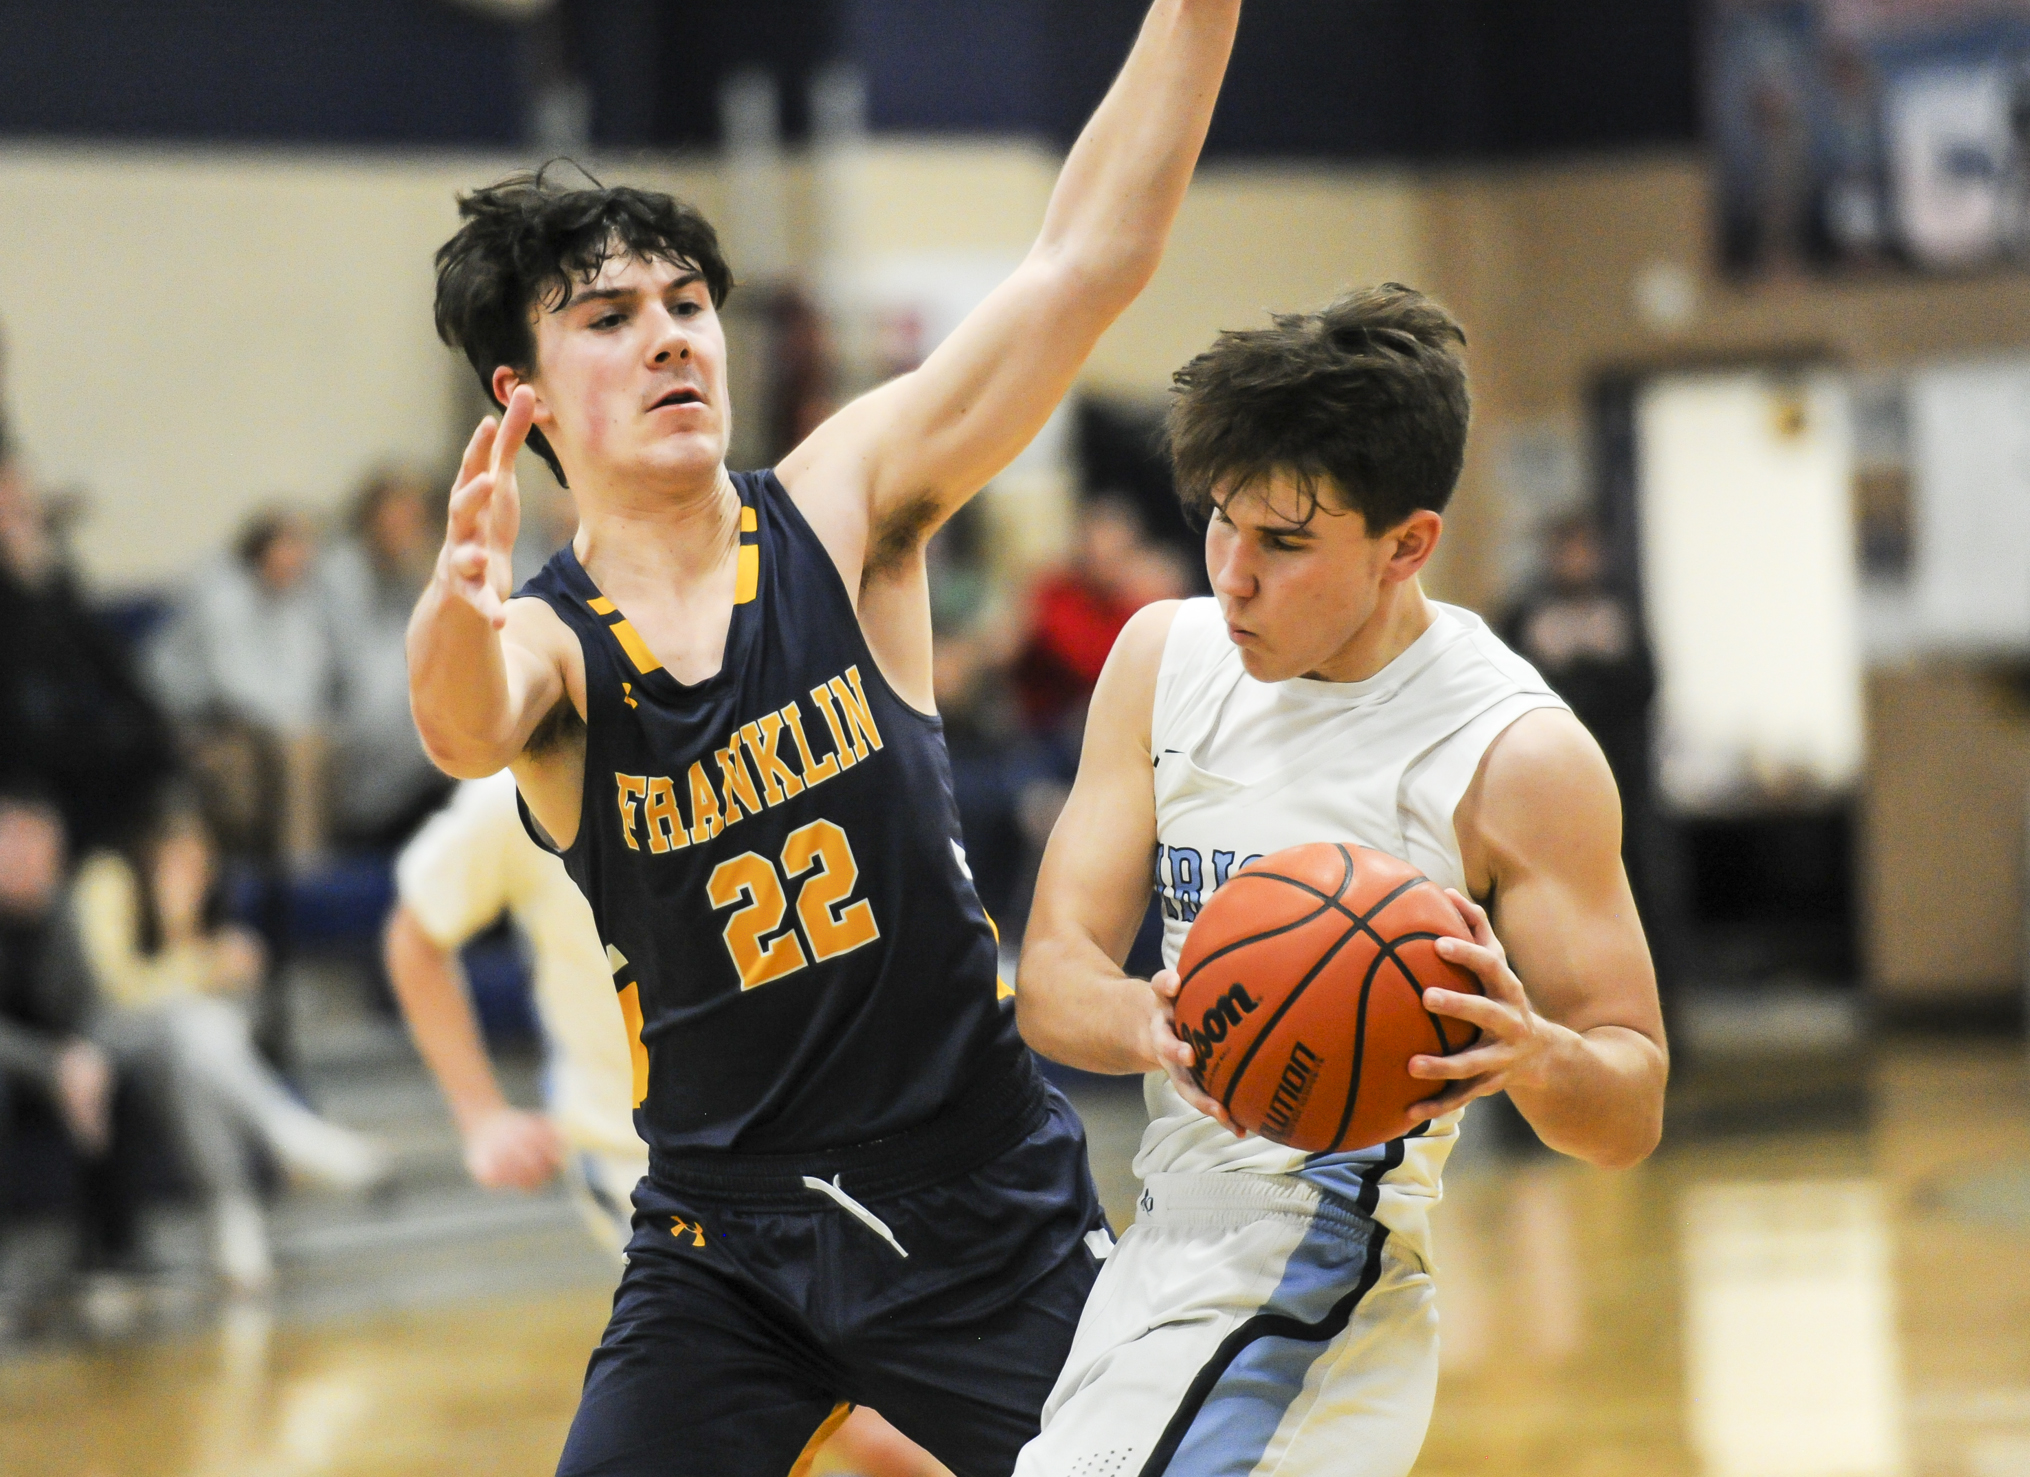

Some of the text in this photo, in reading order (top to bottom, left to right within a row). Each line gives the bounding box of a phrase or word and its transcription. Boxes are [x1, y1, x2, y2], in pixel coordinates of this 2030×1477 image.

[615, 665, 883, 854] FRANKLIN
[706, 818, 880, 991] 22
[1259, 1041, 1317, 1138] LUTION
